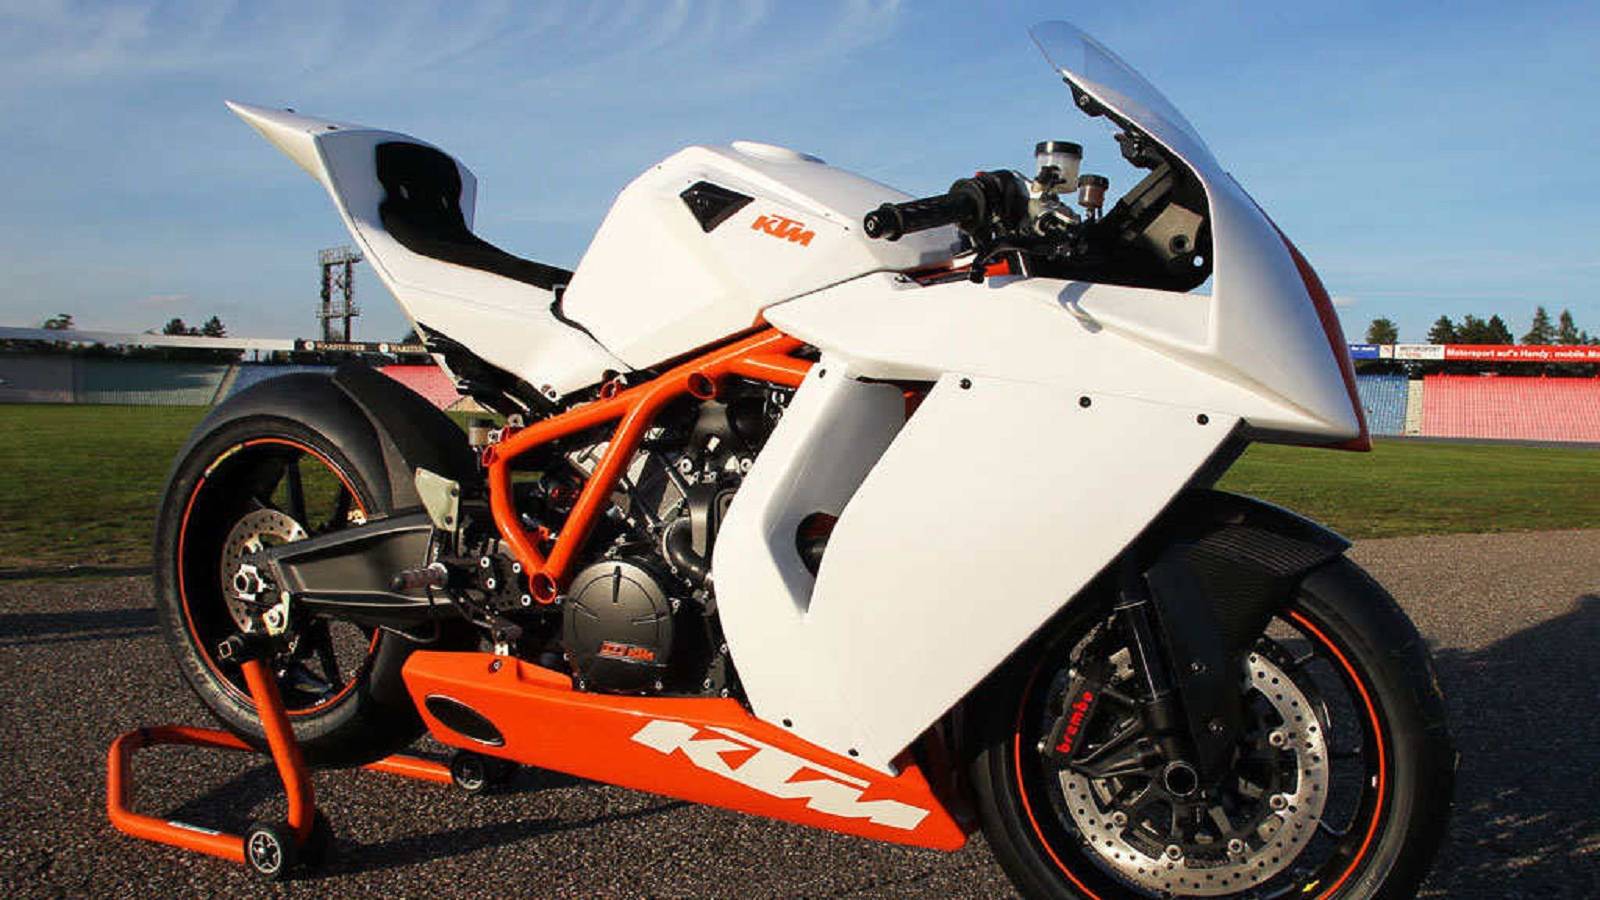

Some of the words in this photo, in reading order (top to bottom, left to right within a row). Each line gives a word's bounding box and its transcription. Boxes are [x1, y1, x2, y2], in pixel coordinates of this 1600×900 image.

[751, 214, 815, 247] KTM
[1446, 348, 1495, 359] Motorsport
[1056, 691, 1094, 753] brembo
[630, 719, 931, 831] KTM
